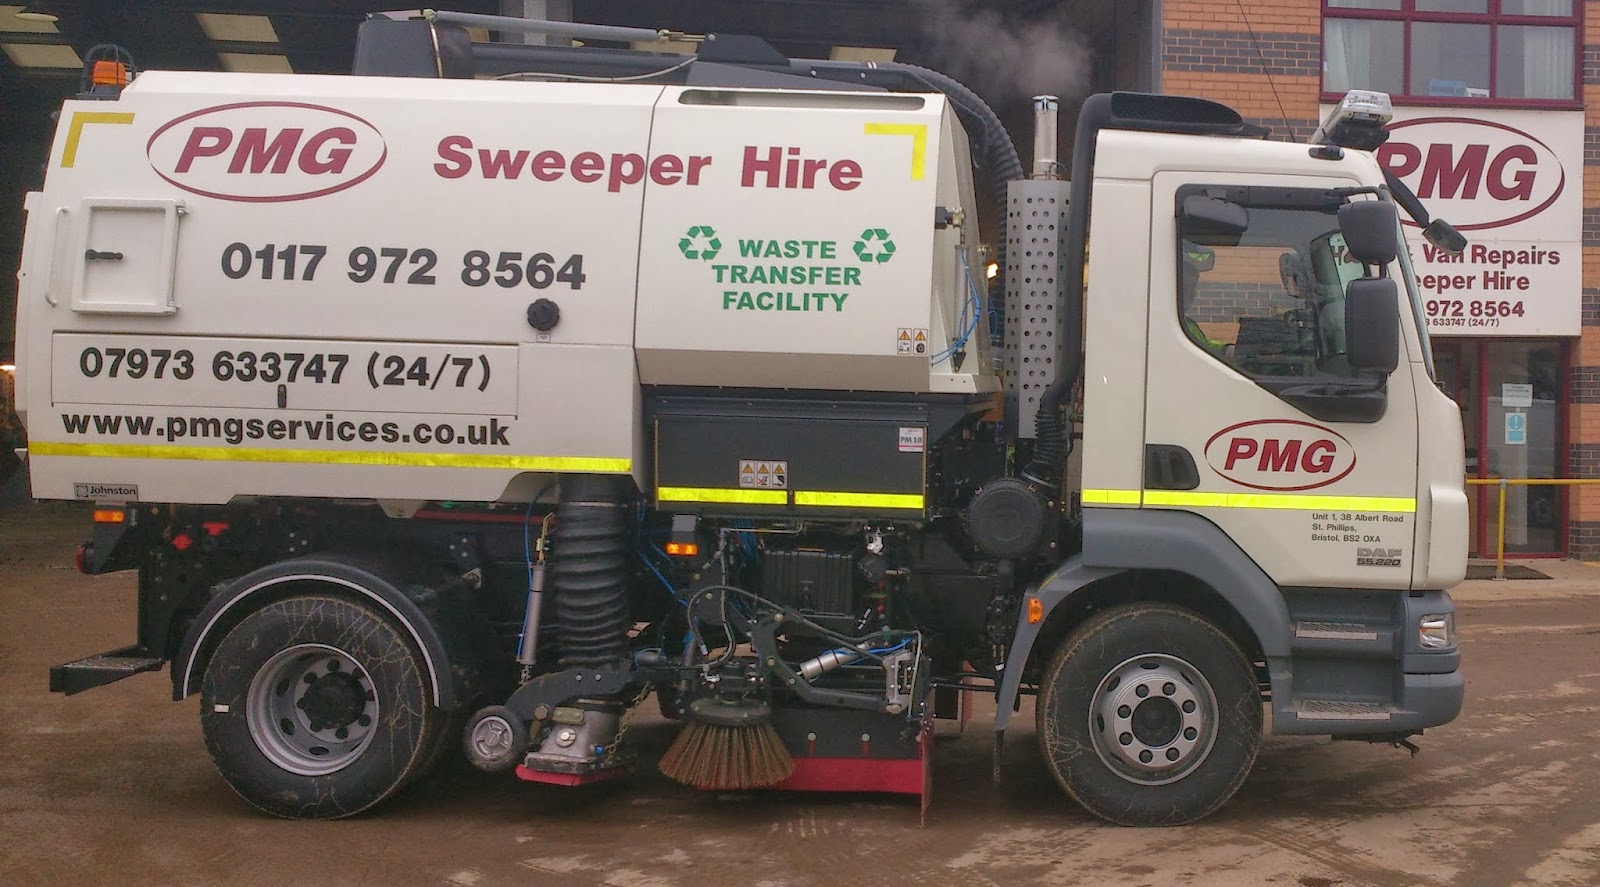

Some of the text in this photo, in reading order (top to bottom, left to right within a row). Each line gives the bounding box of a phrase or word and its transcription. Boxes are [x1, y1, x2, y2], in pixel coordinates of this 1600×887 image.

[173, 126, 358, 175] PMG
[434, 135, 863, 192] Sweeper Hire
[1376, 142, 1538, 200] PMG
[738, 239, 835, 260] WASTE
[1471, 244, 1560, 269] Repairs
[221, 242, 586, 290] 0117 972 8564
[712, 264, 861, 286] TRANSFER
[1482, 270, 1530, 291] Hire
[722, 290, 848, 312] FACILITY
[1426, 299, 1525, 318] 972 8564
[1432, 318, 1466, 327] 633747
[1468, 318, 1500, 328] (24/7)
[79, 346, 490, 393] 07973 633747 (24/7)
[62, 411, 510, 447] www.pmgservices.co.uk
[1224, 437, 1337, 473] PMG
[90, 485, 136, 495] Johnston
[1312, 513, 1328, 521] Unit
[1341, 513, 1352, 521] 38
[1355, 514, 1380, 522] Albert
[1382, 514, 1404, 523] Road
[1312, 523, 1357, 533] St. Phillips,
[1311, 533, 1340, 543] Bristol,
[1343, 534, 1360, 543] BS2
[1356, 547, 1402, 558] DAF
